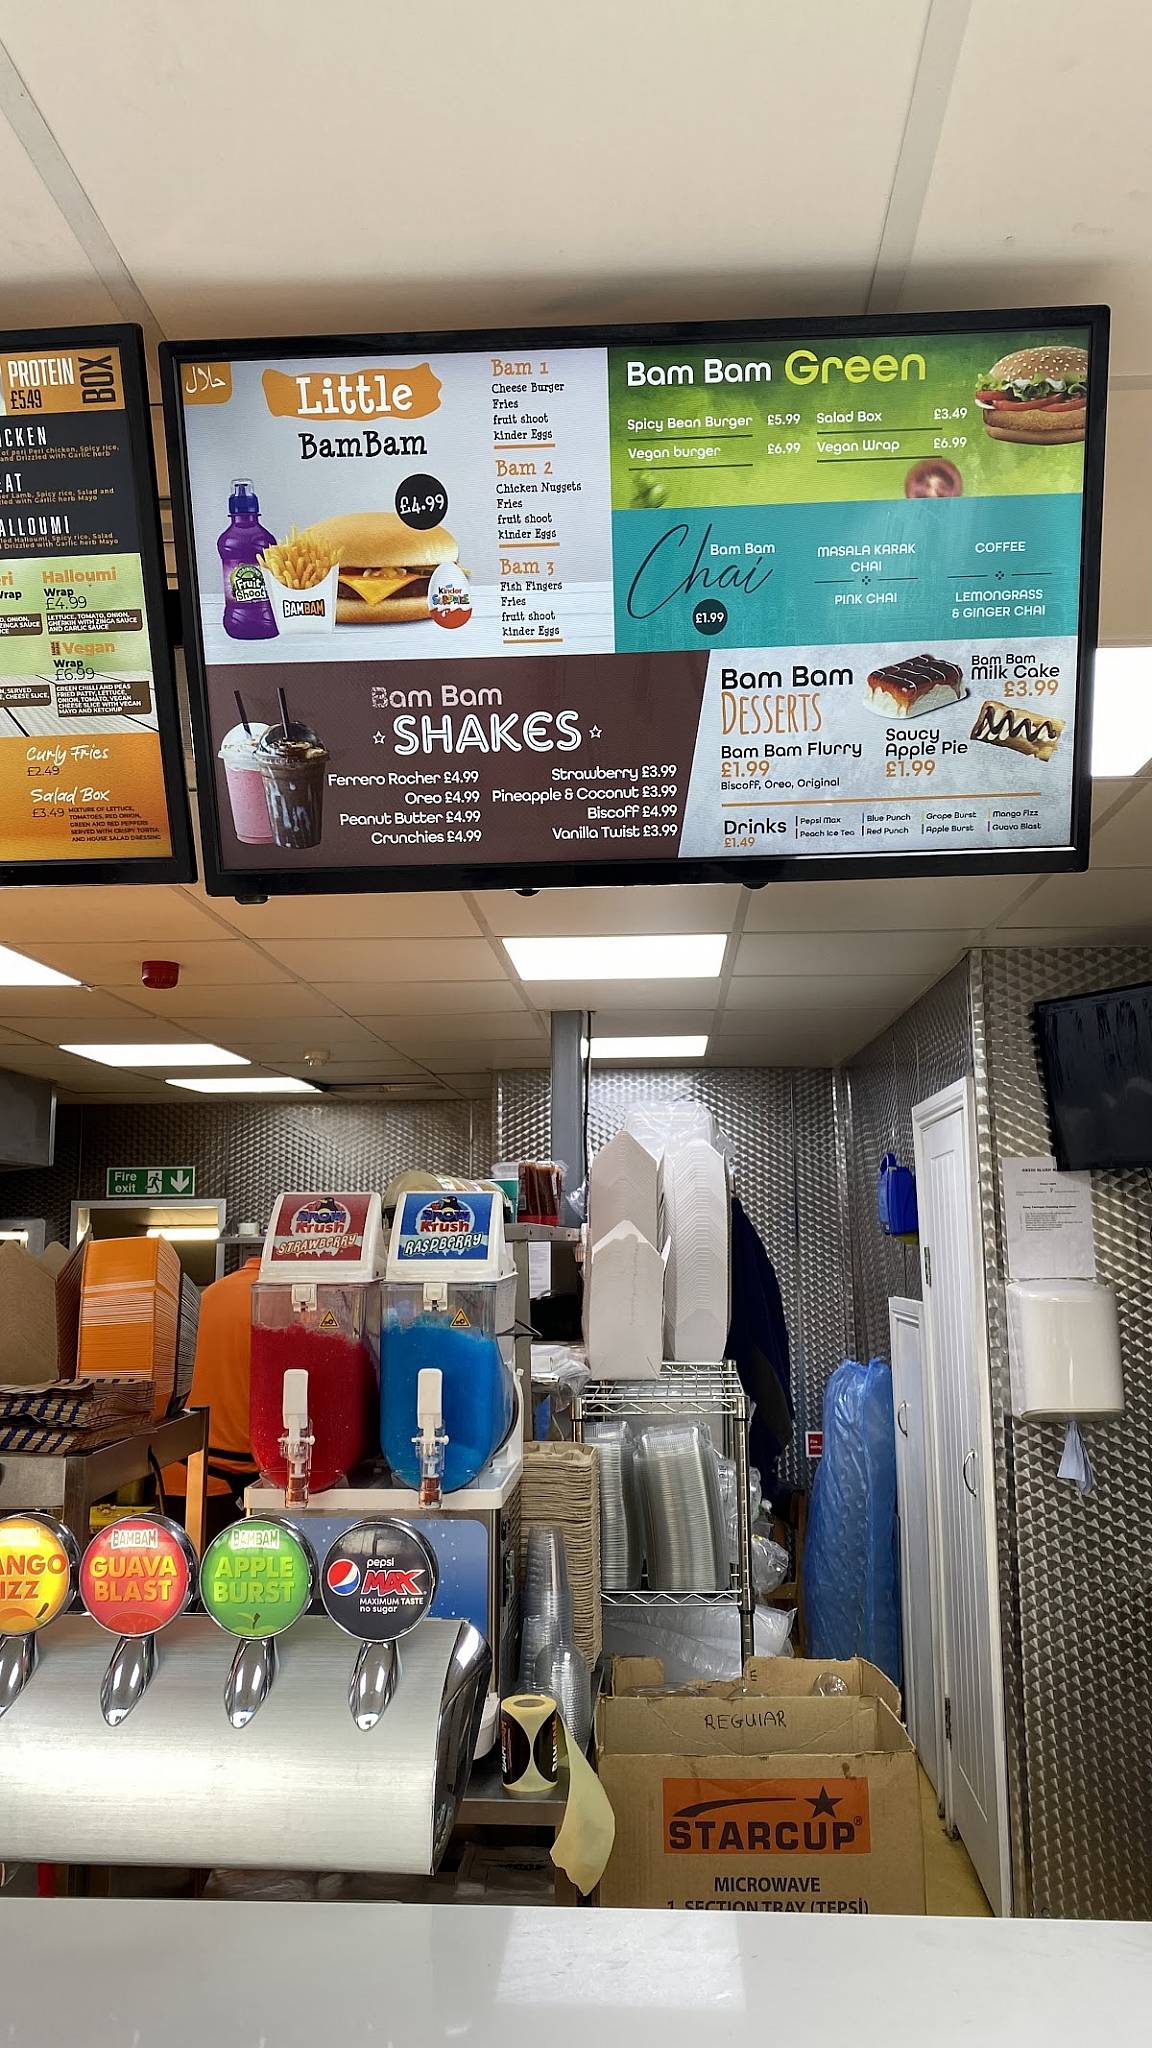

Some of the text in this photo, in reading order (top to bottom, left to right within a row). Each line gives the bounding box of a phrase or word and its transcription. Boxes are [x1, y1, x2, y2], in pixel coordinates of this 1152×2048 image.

[7, 357, 74, 388] PROTEIN
[491, 359, 548, 376] Bam 1
[627, 350, 927, 386] Bam Bam Green
[78, 355, 116, 403] BOX
[186, 365, 226, 393] حلال
[296, 375, 413, 415] Little
[492, 383, 564, 393] Cheese Burger
[11, 389, 42, 409] £5.49
[492, 399, 518, 409] Fries
[493, 413, 548, 425] fruit shoot
[768, 413, 800, 425] £5.99
[817, 411, 882, 423] Salad Box
[934, 408, 967, 420] £3.49
[628, 416, 752, 432] Spicy Bean Burger
[494, 429, 552, 440] kinder Eggs
[299, 430, 427, 459] BamBam
[768, 442, 800, 454] £6.99
[817, 440, 900, 454] Vegan Wrap
[934, 437, 967, 448] £6.99
[628, 446, 720, 461] Vegan burger
[496, 460, 552, 476] Bam 2
[496, 482, 581, 494] Chicken Nuggets
[400, 494, 444, 514] £4.99
[497, 499, 522, 508] Fries
[498, 513, 552, 524] fruit shoot
[498, 529, 556, 539] kinder Eggs
[711, 543, 775, 555] Bam Bam
[818, 543, 915, 557] MASALA KARAK
[976, 541, 1025, 553] COFFEE
[499, 559, 553, 575] Bam 3
[627, 523, 773, 619] Chai
[851, 561, 881, 572] CHAI
[42, 567, 116, 584] Halloumi
[44, 588, 74, 597] Wrap
[501, 581, 562, 591] Fish Fingers
[501, 597, 526, 606] Fries
[835, 593, 897, 604] PINK CHAI
[956, 589, 1043, 602] LEMONGRASS
[46, 596, 86, 610] £4.99
[283, 599, 325, 617] BAMBAM
[502, 611, 555, 621] fruit shoot
[696, 612, 724, 623] £1.99
[963, 605, 1045, 618] GINGER CHAI
[502, 626, 559, 636] kinder Eggs
[63, 642, 115, 656] Vegan
[54, 660, 83, 669] Wrap
[972, 654, 1035, 665] Bam Bam
[55, 668, 94, 680] £6.99
[721, 666, 853, 689] Bam Bam
[972, 663, 1059, 680] Milk Cake
[1004, 679, 1058, 697] £3.99
[371, 685, 502, 709] Bam Bam
[722, 691, 822, 735] DESSERTS
[393, 710, 582, 756] SHAKES
[886, 728, 939, 743] Saucy
[27, 744, 109, 766] Curly Fries
[721, 742, 862, 759] Bam Bam Flurry
[886, 740, 968, 759] Apple Pie
[27, 766, 59, 776] £2.49
[552, 765, 677, 781] Strawberry £3.99
[721, 761, 770, 777] £1.99
[886, 760, 936, 777] £1.99
[328, 771, 479, 786] Ferrero Rocher £4.99
[721, 777, 840, 790] Biscoff, Oreo, Original
[31, 787, 110, 805] Salad Box
[405, 791, 479, 804] Oreo £4.99
[492, 785, 677, 805] Pineapple & Coconut £3.99
[32, 808, 65, 817] £3.49
[340, 811, 481, 825] Peanut Butter £4.99
[588, 805, 677, 819] Biscoff £4.99
[927, 813, 951, 821] Grape
[724, 818, 786, 834] Drinks
[801, 817, 821, 825] Pepsi
[552, 824, 677, 839] Vanilla Twist £3.99
[927, 825, 948, 833] Apple
[371, 830, 481, 844] Crunchies £4.99
[724, 837, 755, 848] £1.49
[115, 1172, 136, 1181] Fire
[115, 1183, 135, 1192] exit
[296, 1223, 344, 1233] Krush
[421, 1221, 469, 1232] Krush
[113, 1531, 157, 1547] BAMBAM
[233, 1531, 279, 1548] BAMBAM
[90, 1555, 177, 1578] GUAVA
[215, 1556, 293, 1578] APPLE
[367, 1558, 394, 1568] pepsi
[94, 1579, 173, 1601] BLAST
[361, 1570, 425, 1596] MAX
[213, 1581, 295, 1603] BURST
[372, 1606, 397, 1614] sugar
[669, 1821, 856, 1850] STARCUP
[715, 1877, 820, 1892] MICROWAVE
